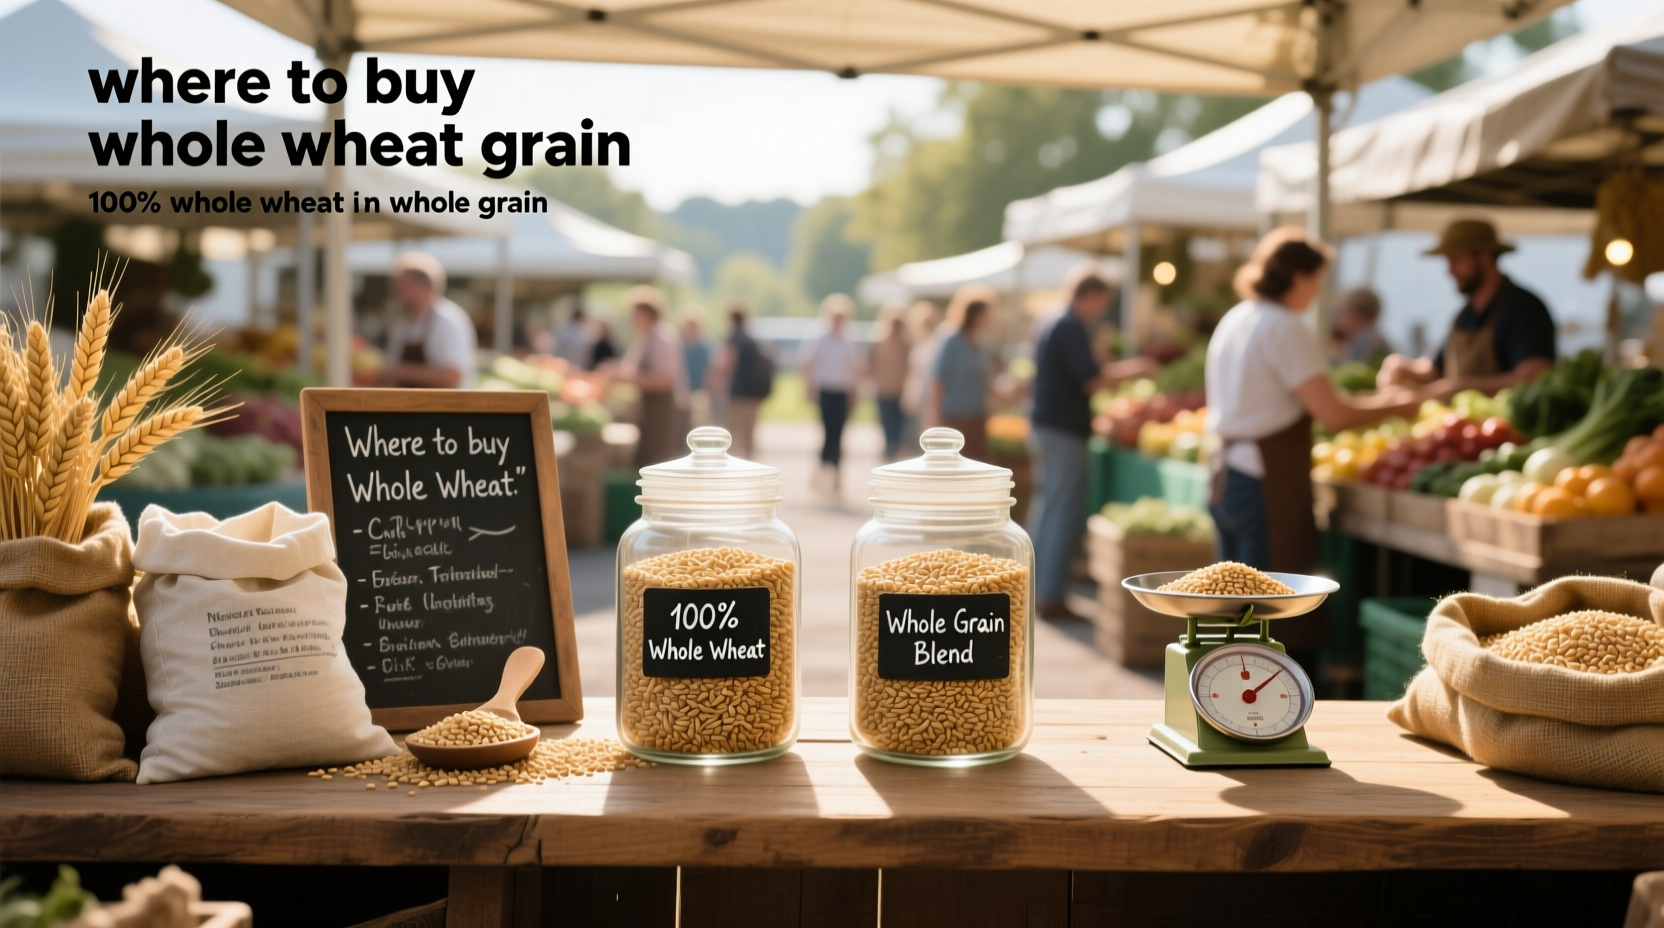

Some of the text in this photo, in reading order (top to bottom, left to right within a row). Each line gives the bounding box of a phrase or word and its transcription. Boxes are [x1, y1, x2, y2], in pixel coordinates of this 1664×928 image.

[344, 424, 510, 466] Where to buy
[346, 469, 428, 503] Whole
[670, 599, 739, 631] 100%
[885, 607, 1005, 634] Whole Grain
[648, 637, 766, 661] Whole Wheat
[913, 639, 974, 666] Blend
